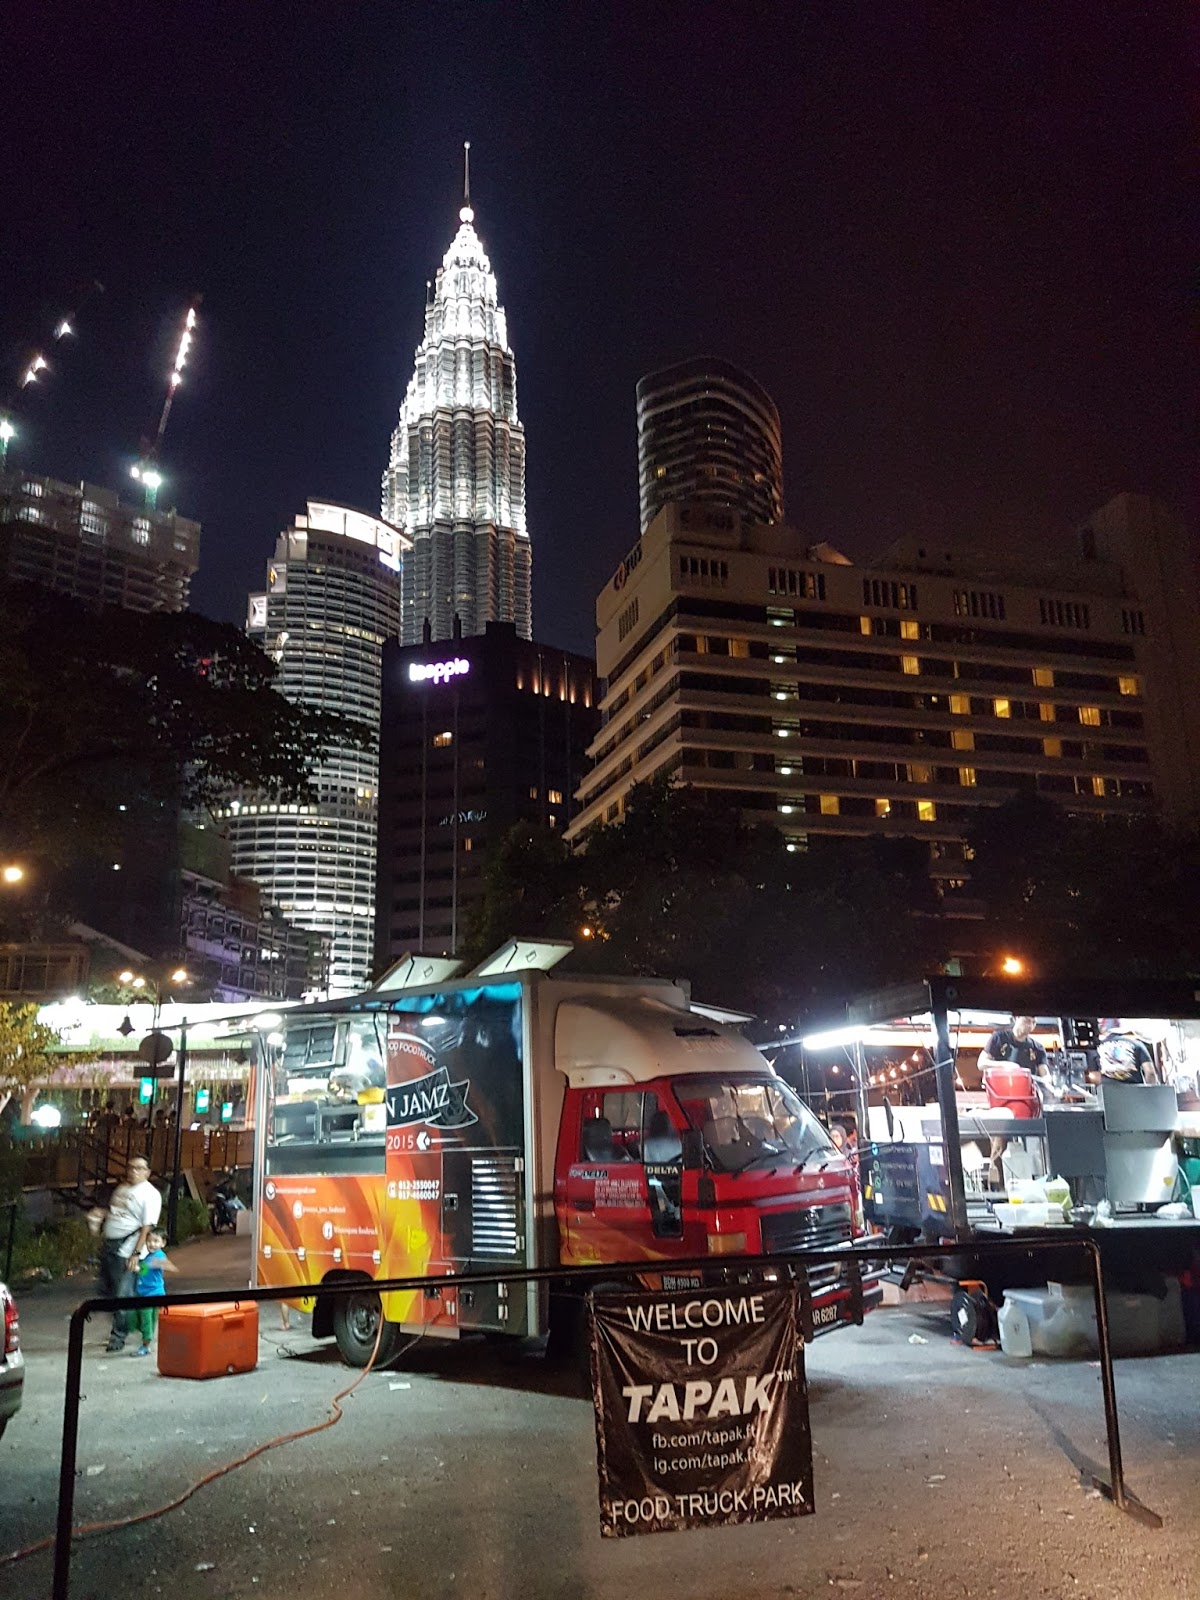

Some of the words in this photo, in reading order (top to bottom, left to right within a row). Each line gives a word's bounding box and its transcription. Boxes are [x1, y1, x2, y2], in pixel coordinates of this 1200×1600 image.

[400, 1083, 450, 1117] JAMZ
[387, 1135, 414, 1150] 2015
[647, 1165, 679, 1175] DELTA
[626, 1295, 766, 1332] WELCOME
[821, 1304, 837, 1323] 6287
[680, 1337, 719, 1366] TO
[622, 1373, 776, 1424] TAPAK
[652, 1424, 757, 1450] fb.com/tapak.ft
[612, 1498, 670, 1525] FOOD
[675, 1489, 748, 1518] TRUCK
[753, 1480, 805, 1510] PARK
